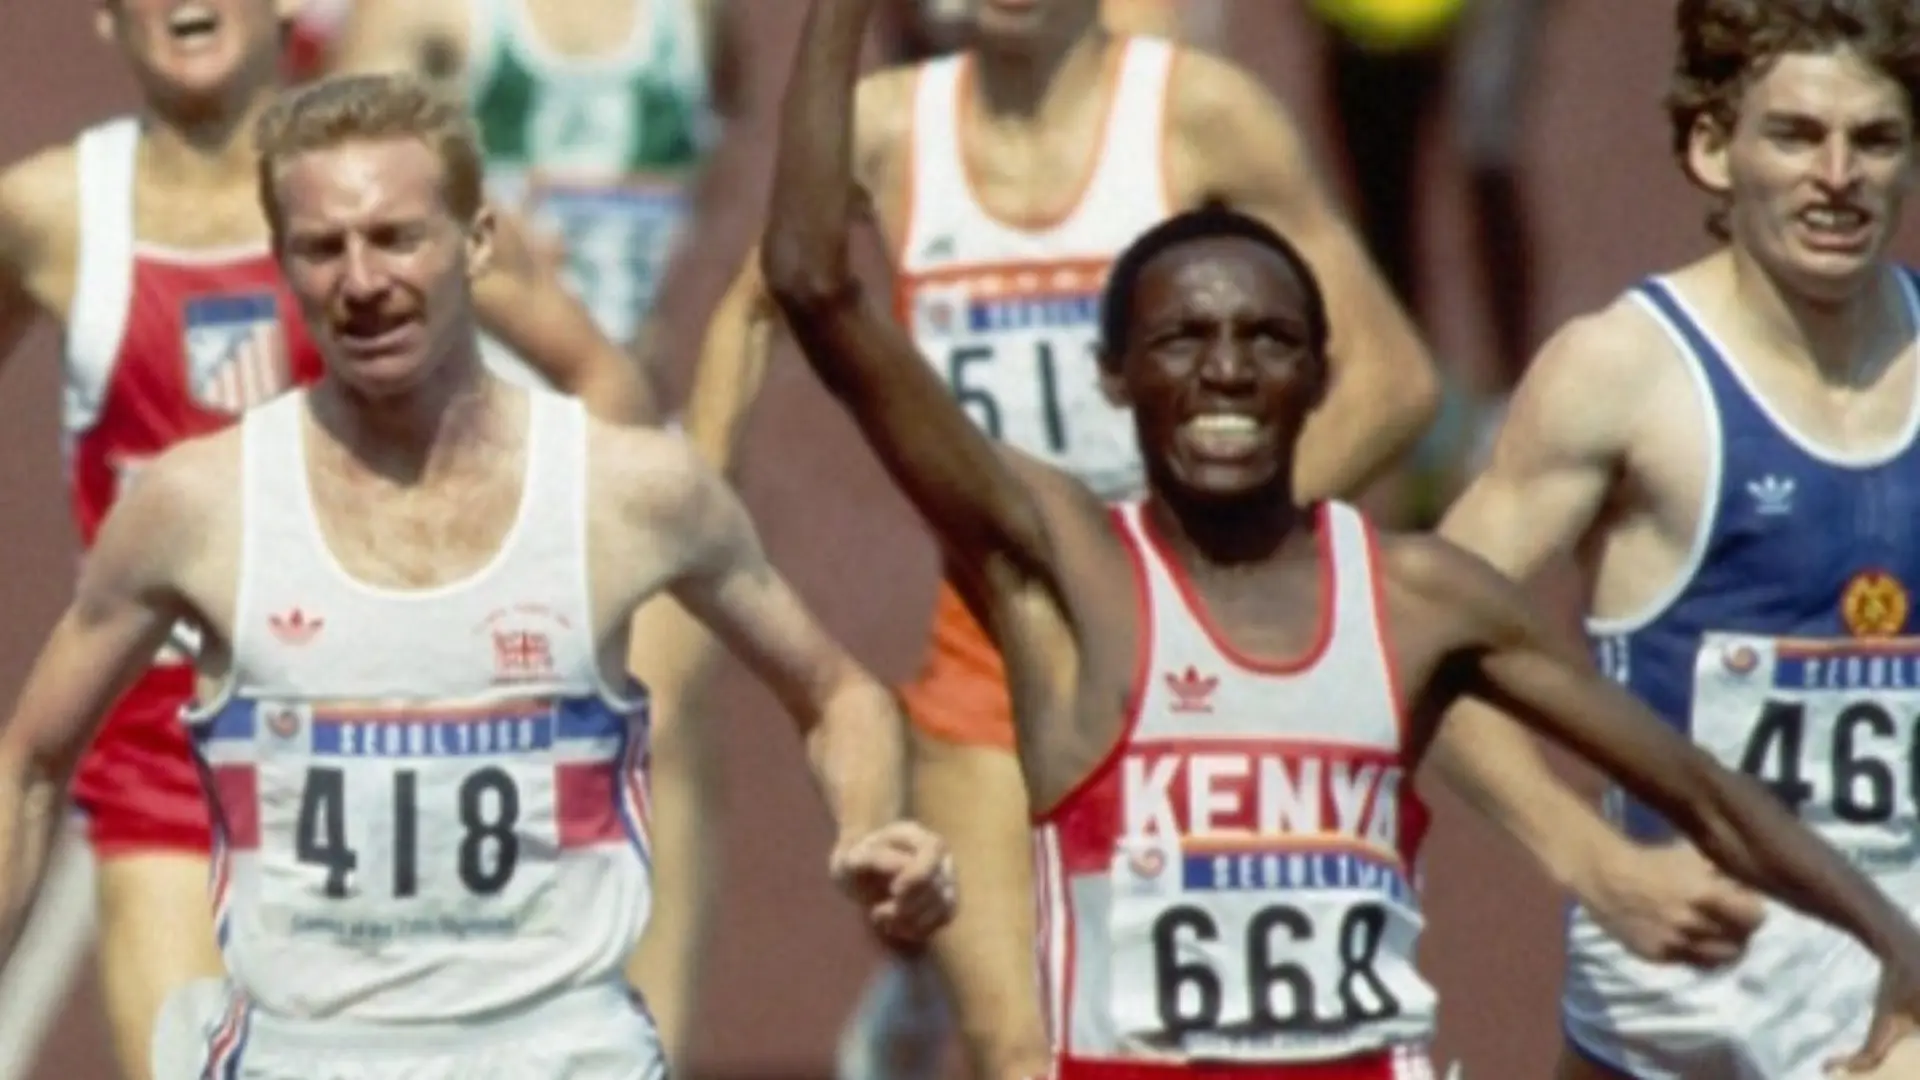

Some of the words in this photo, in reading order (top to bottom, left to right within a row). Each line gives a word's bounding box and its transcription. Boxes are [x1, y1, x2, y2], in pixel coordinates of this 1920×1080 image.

[950, 339, 1102, 452] 51
[1122, 754, 1402, 840] KENYA
[1741, 699, 1920, 824] 46
[296, 766, 519, 898] 418
[1152, 904, 1399, 1034] 668
